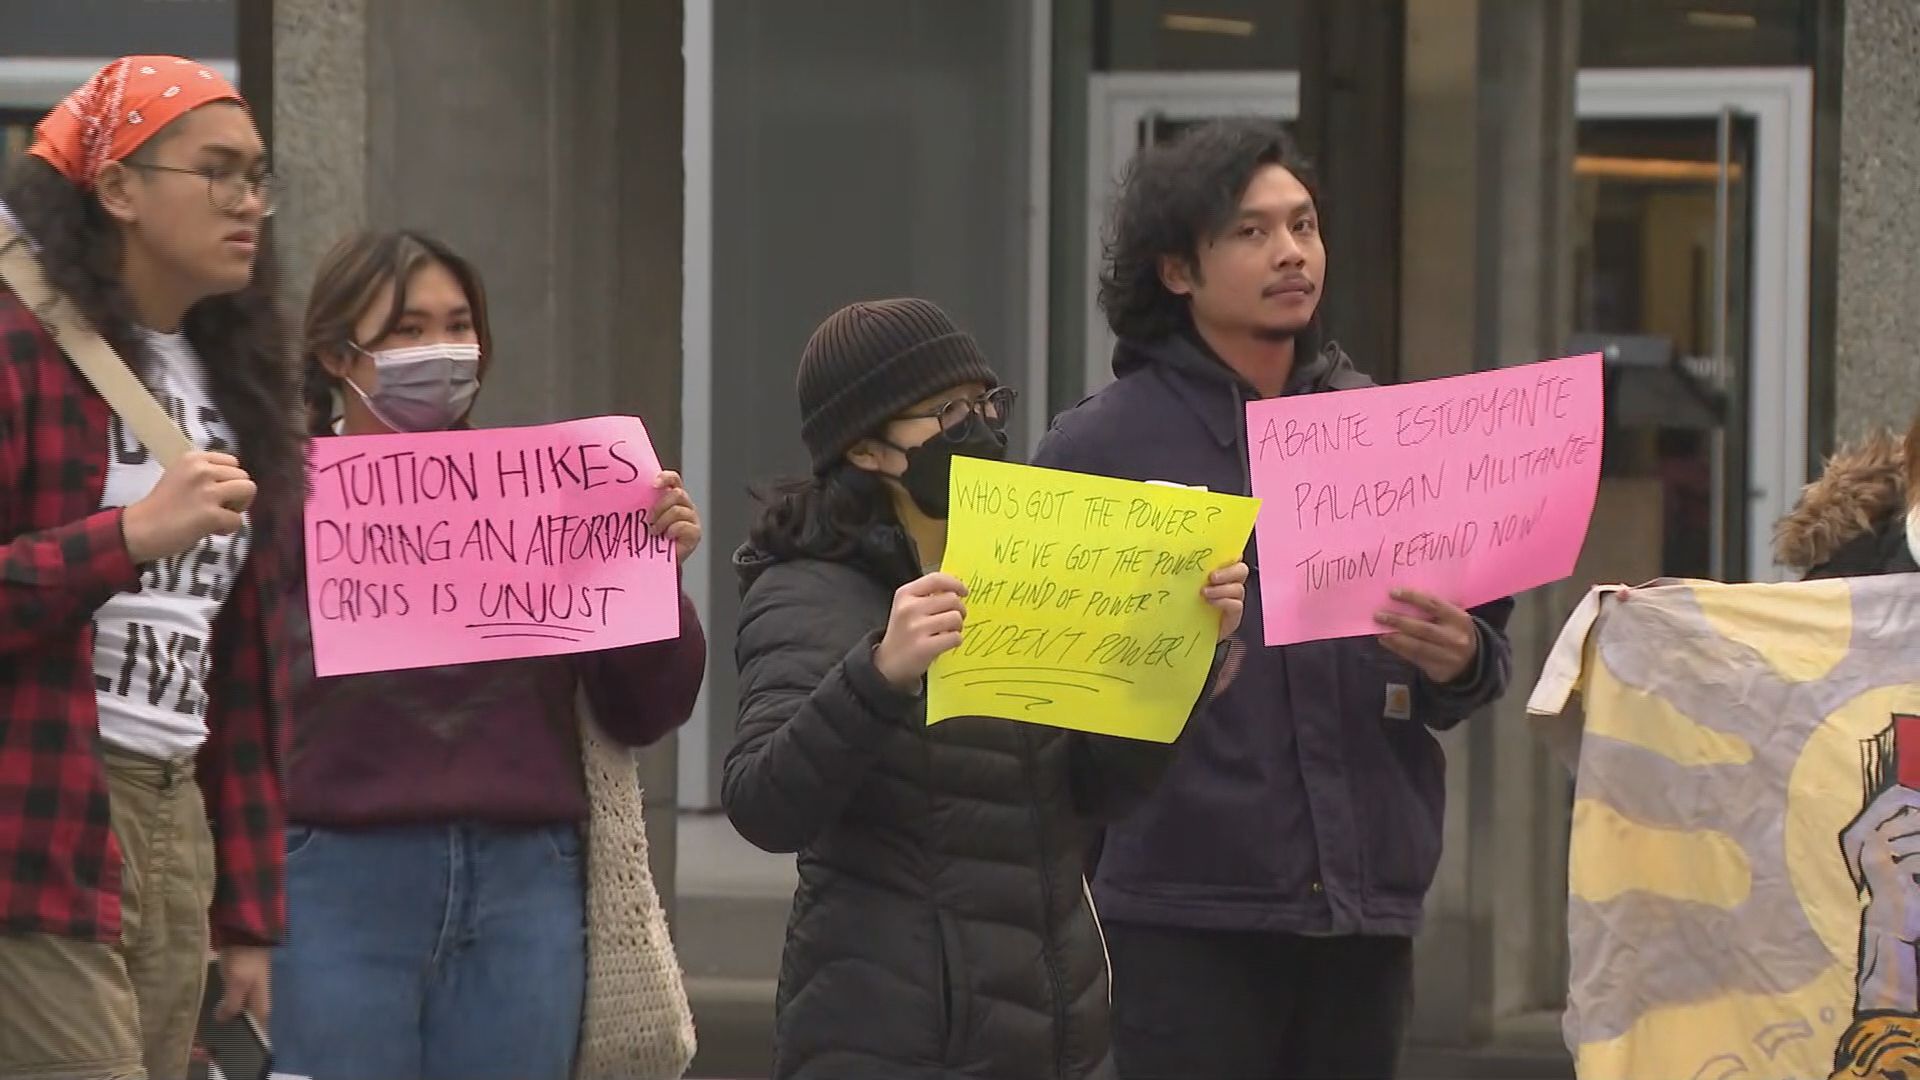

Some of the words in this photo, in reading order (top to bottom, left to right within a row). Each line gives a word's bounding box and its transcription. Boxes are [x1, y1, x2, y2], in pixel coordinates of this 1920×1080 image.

[1259, 412, 1373, 462] ABANTE
[1396, 374, 1575, 447] ESTUDYANTE
[320, 451, 478, 509] TUITION
[498, 441, 638, 499] HIKES
[1295, 460, 1446, 530] PALABAN
[954, 474, 1020, 520] WHO'S
[1025, 489, 1074, 525] GOT
[1084, 496, 1120, 530] THE
[316, 520, 452, 566] DURING
[460, 519, 517, 563] AN
[993, 534, 1060, 569] WE'VE
[1065, 543, 1111, 573] GOT
[1110, 545, 1153, 577] THE
[1150, 547, 1213, 577] POWER
[1295, 536, 1386, 593] TUITION
[1391, 521, 1477, 577] REFUND
[319, 577, 410, 623] CRISIS
[432, 582, 458, 615] IS
[480, 582, 625, 626] UNJUST
[1006, 576, 1057, 610] KIND
[1056, 588, 1081, 610] OF
[952, 618, 1087, 664] TUDENT
[1085, 631, 1201, 669] POWER!
